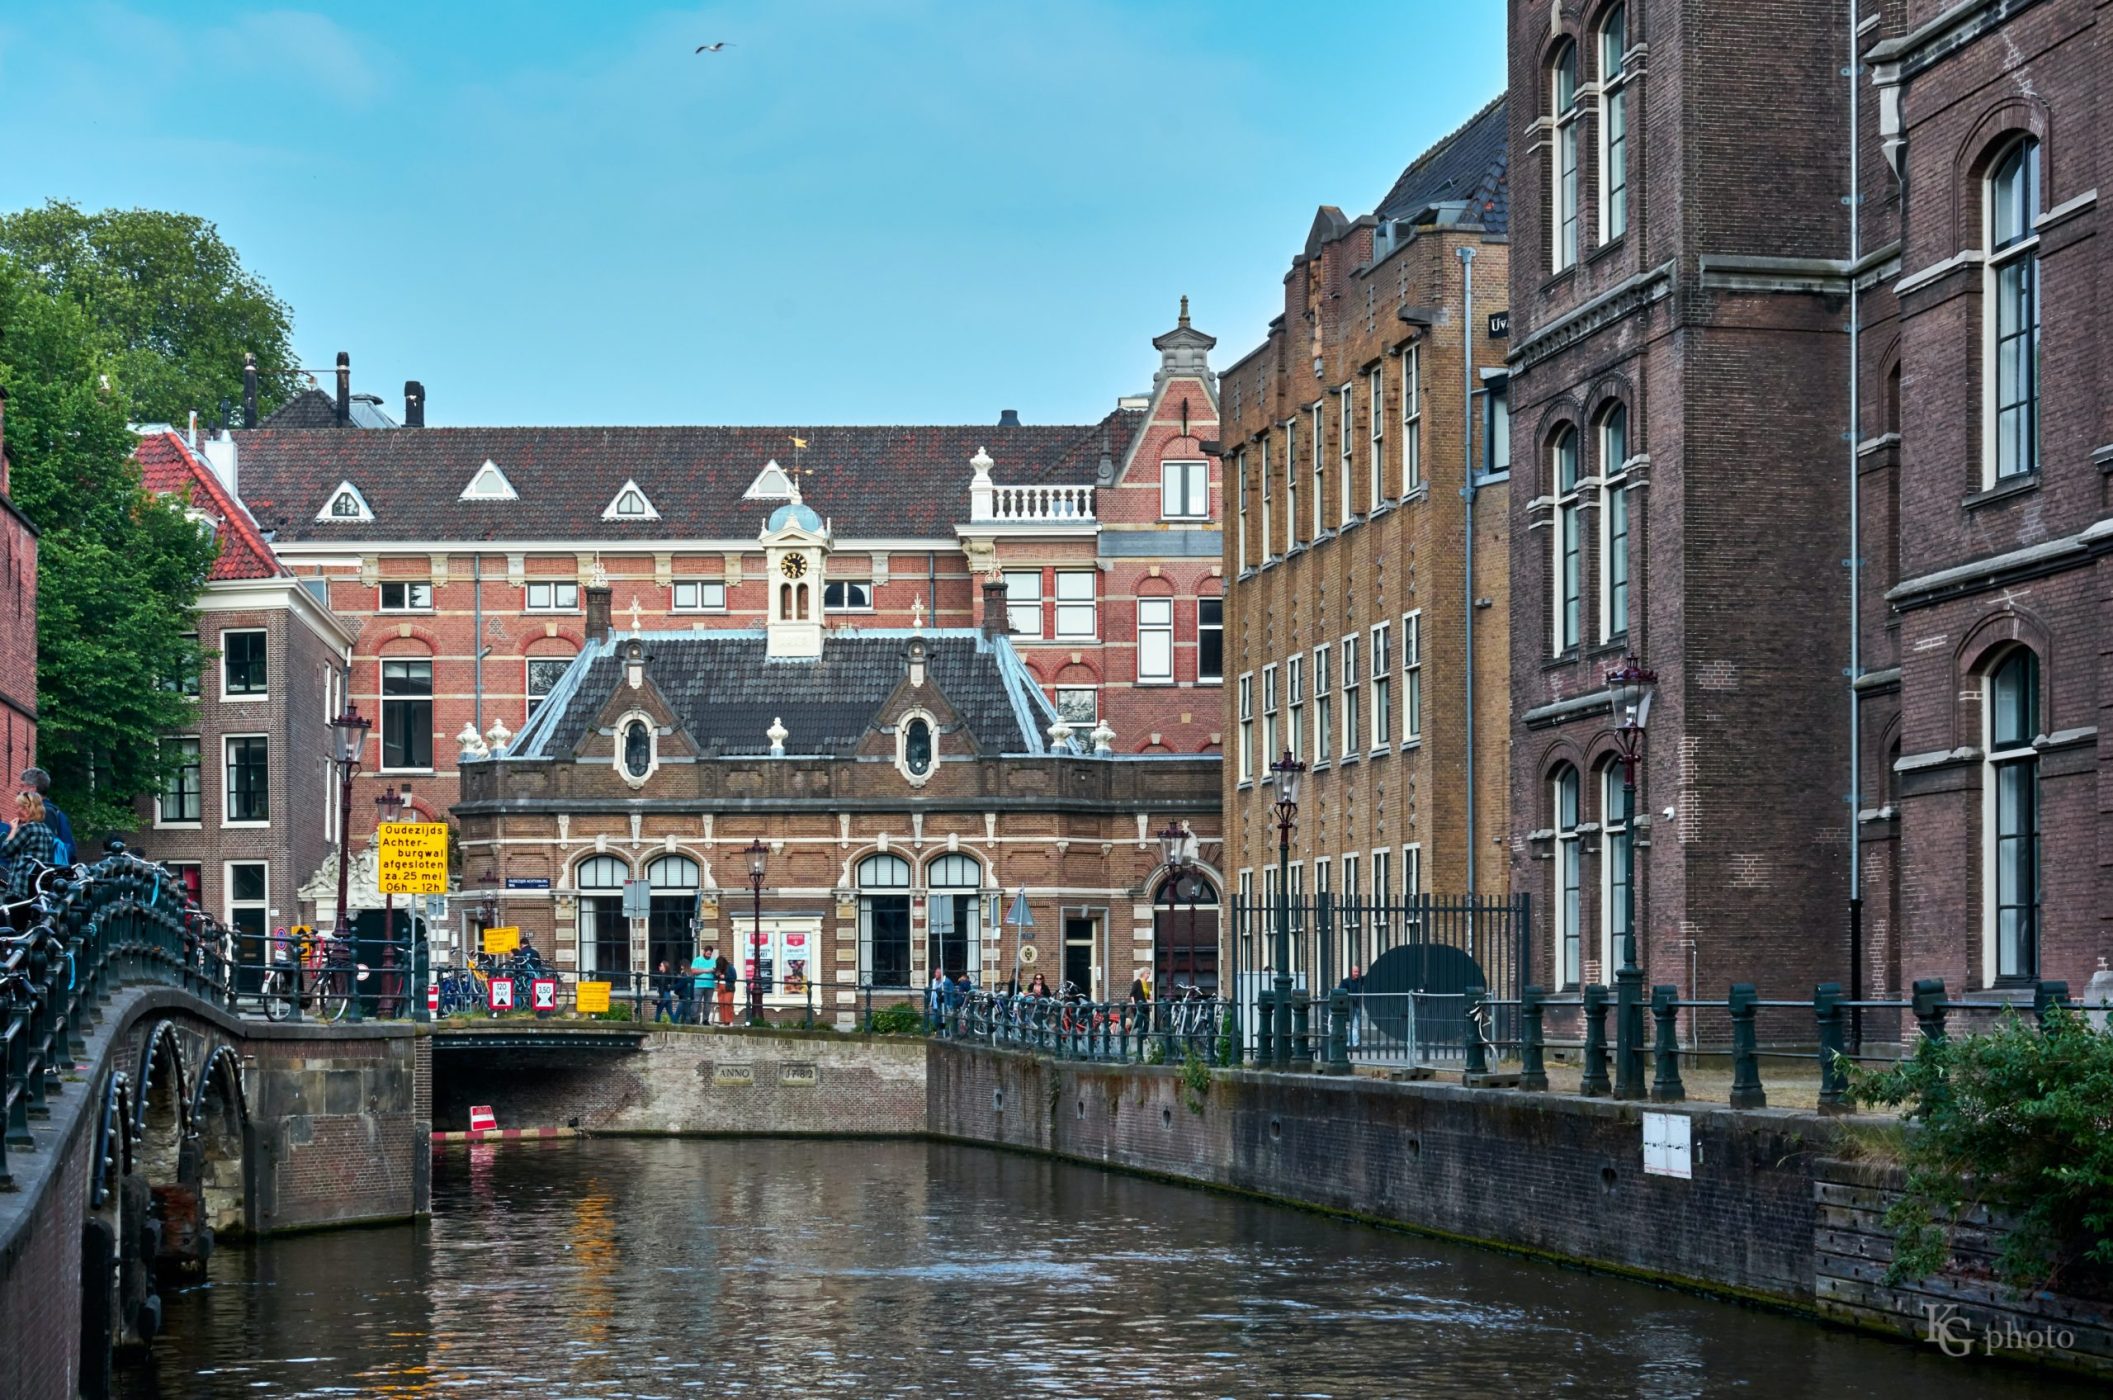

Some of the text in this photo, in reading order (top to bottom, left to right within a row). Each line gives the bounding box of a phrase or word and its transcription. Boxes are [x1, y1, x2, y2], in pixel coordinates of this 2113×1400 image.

[1491, 318, 1509, 332] Uv
[385, 825, 443, 837] Oudezijds
[382, 838, 428, 847] Achter-
[398, 849, 444, 859] burgwal
[383, 860, 444, 870] afgesloten
[421, 872, 442, 880] mei
[386, 883, 407, 892] 06h
[422, 883, 440, 892] 12h
[721, 1068, 813, 1079] ANNO 1782
